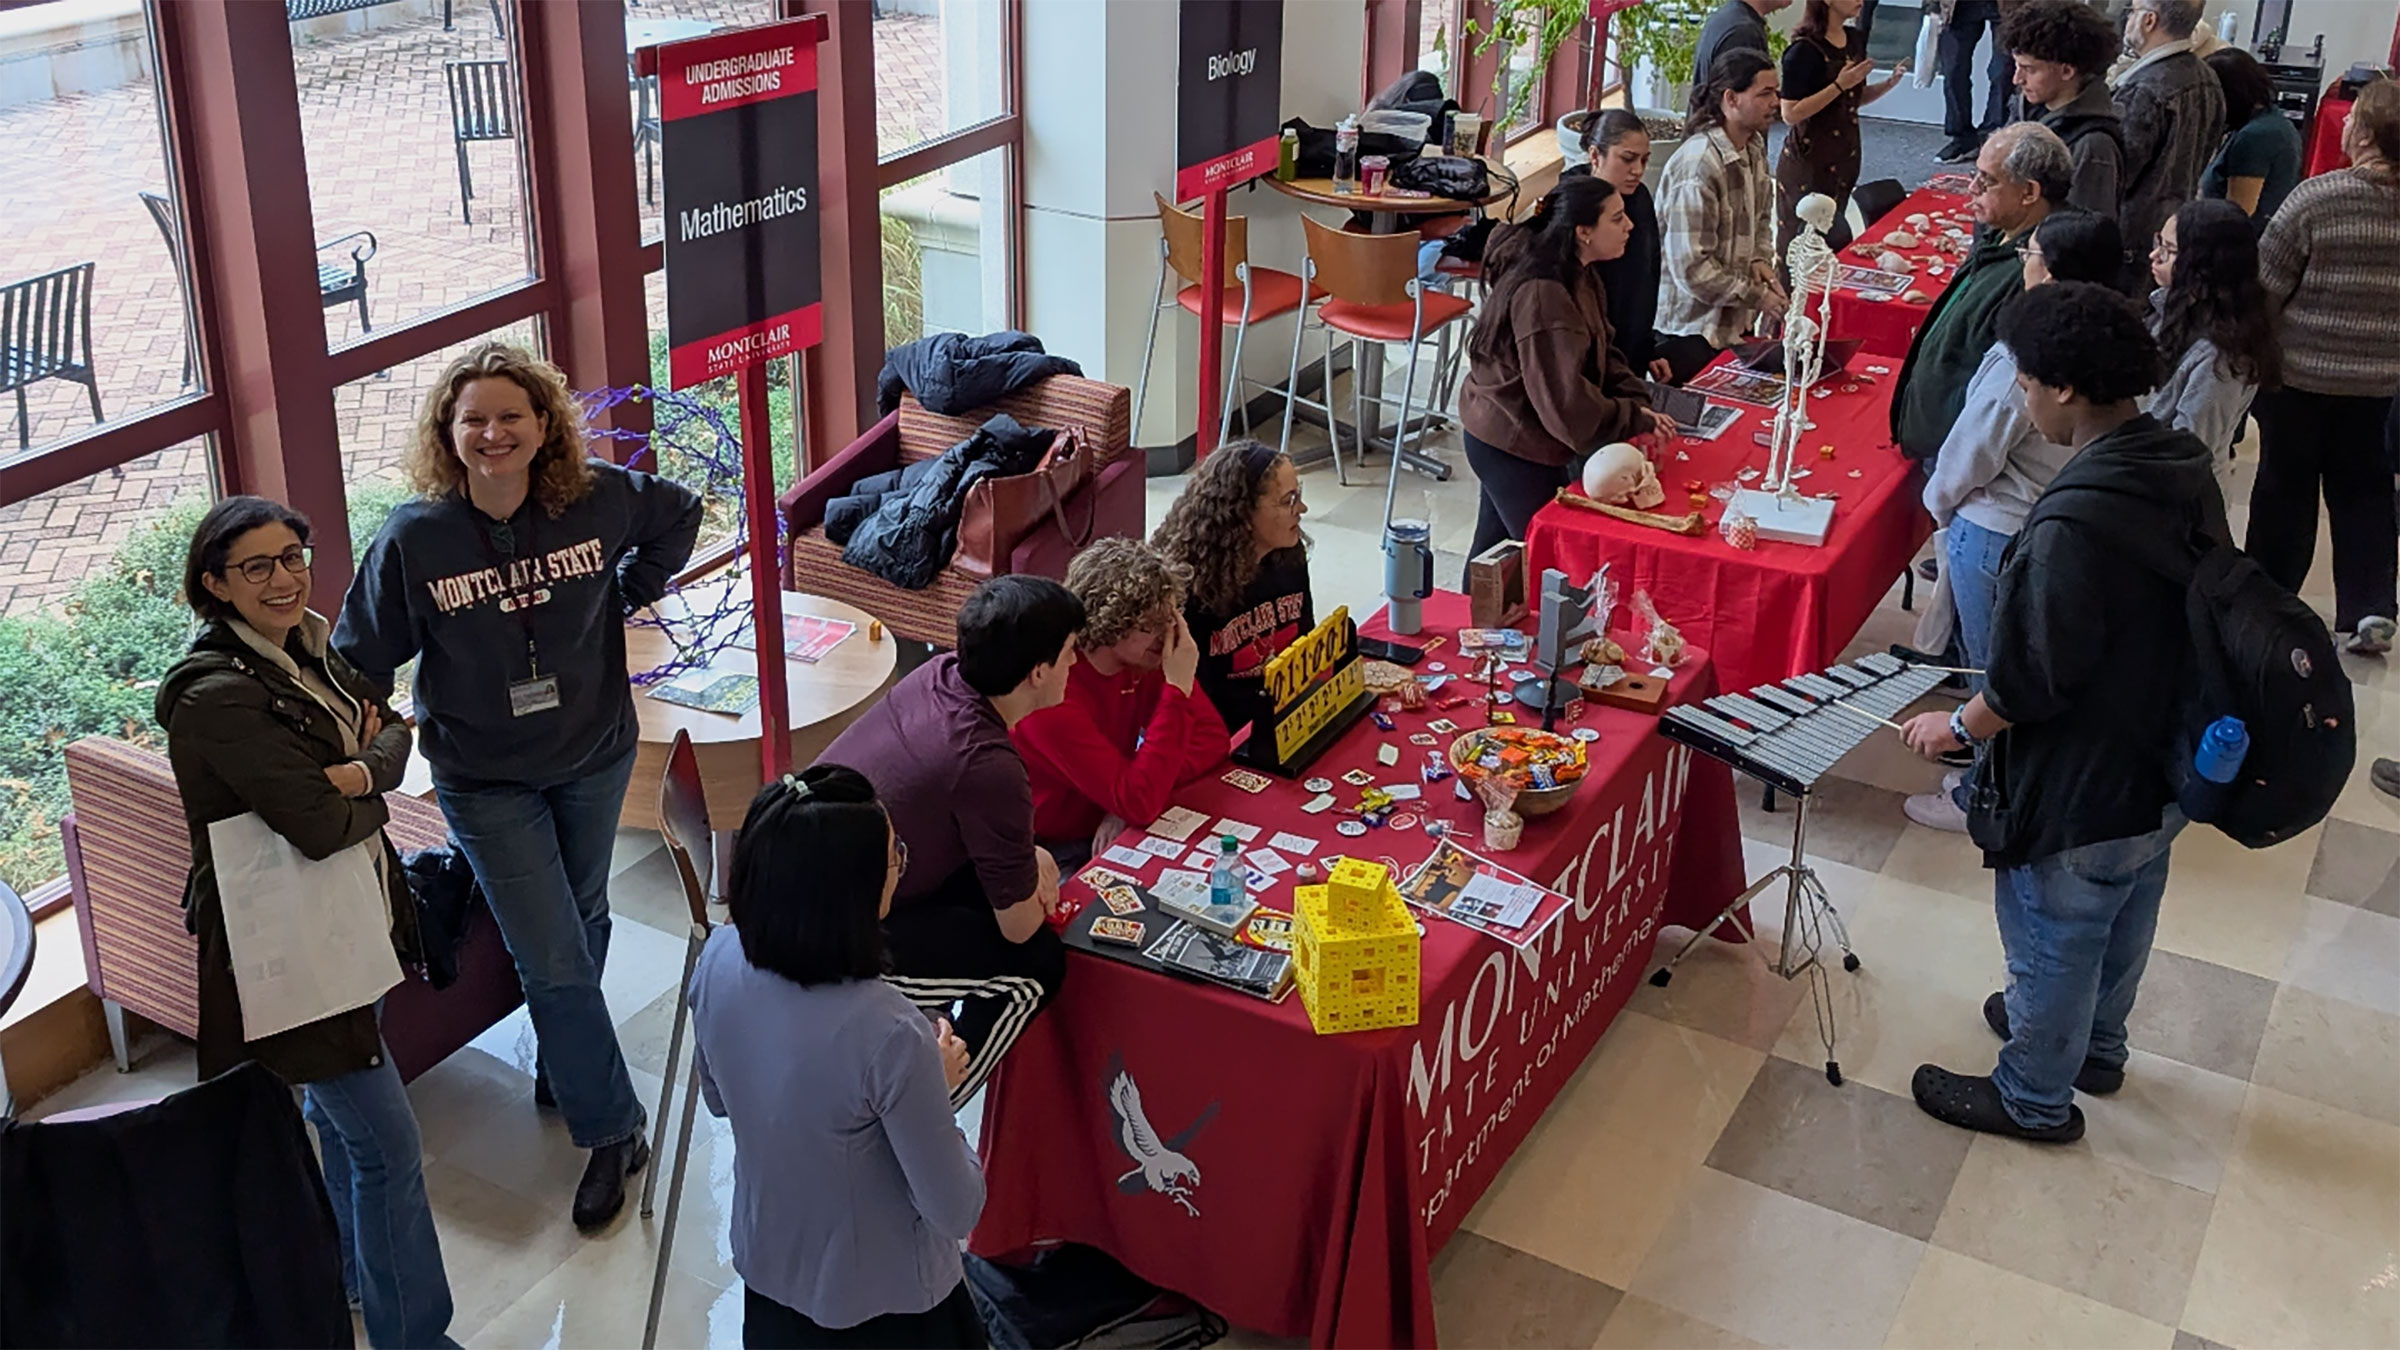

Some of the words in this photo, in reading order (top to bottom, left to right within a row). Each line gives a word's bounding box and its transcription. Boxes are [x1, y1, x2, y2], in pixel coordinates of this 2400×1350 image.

[686, 46, 795, 85] UNDERGRADUATE
[1208, 48, 1257, 81] Biology
[702, 71, 781, 105] ADMISSIONS
[1204, 151, 1253, 178] MONTCLAIR
[680, 185, 807, 242] Mathematics
[708, 323, 790, 364] MONTCLAIR
[547, 538, 604, 580] STATE
[1519, 831, 1676, 1046] UNIVERSIT
